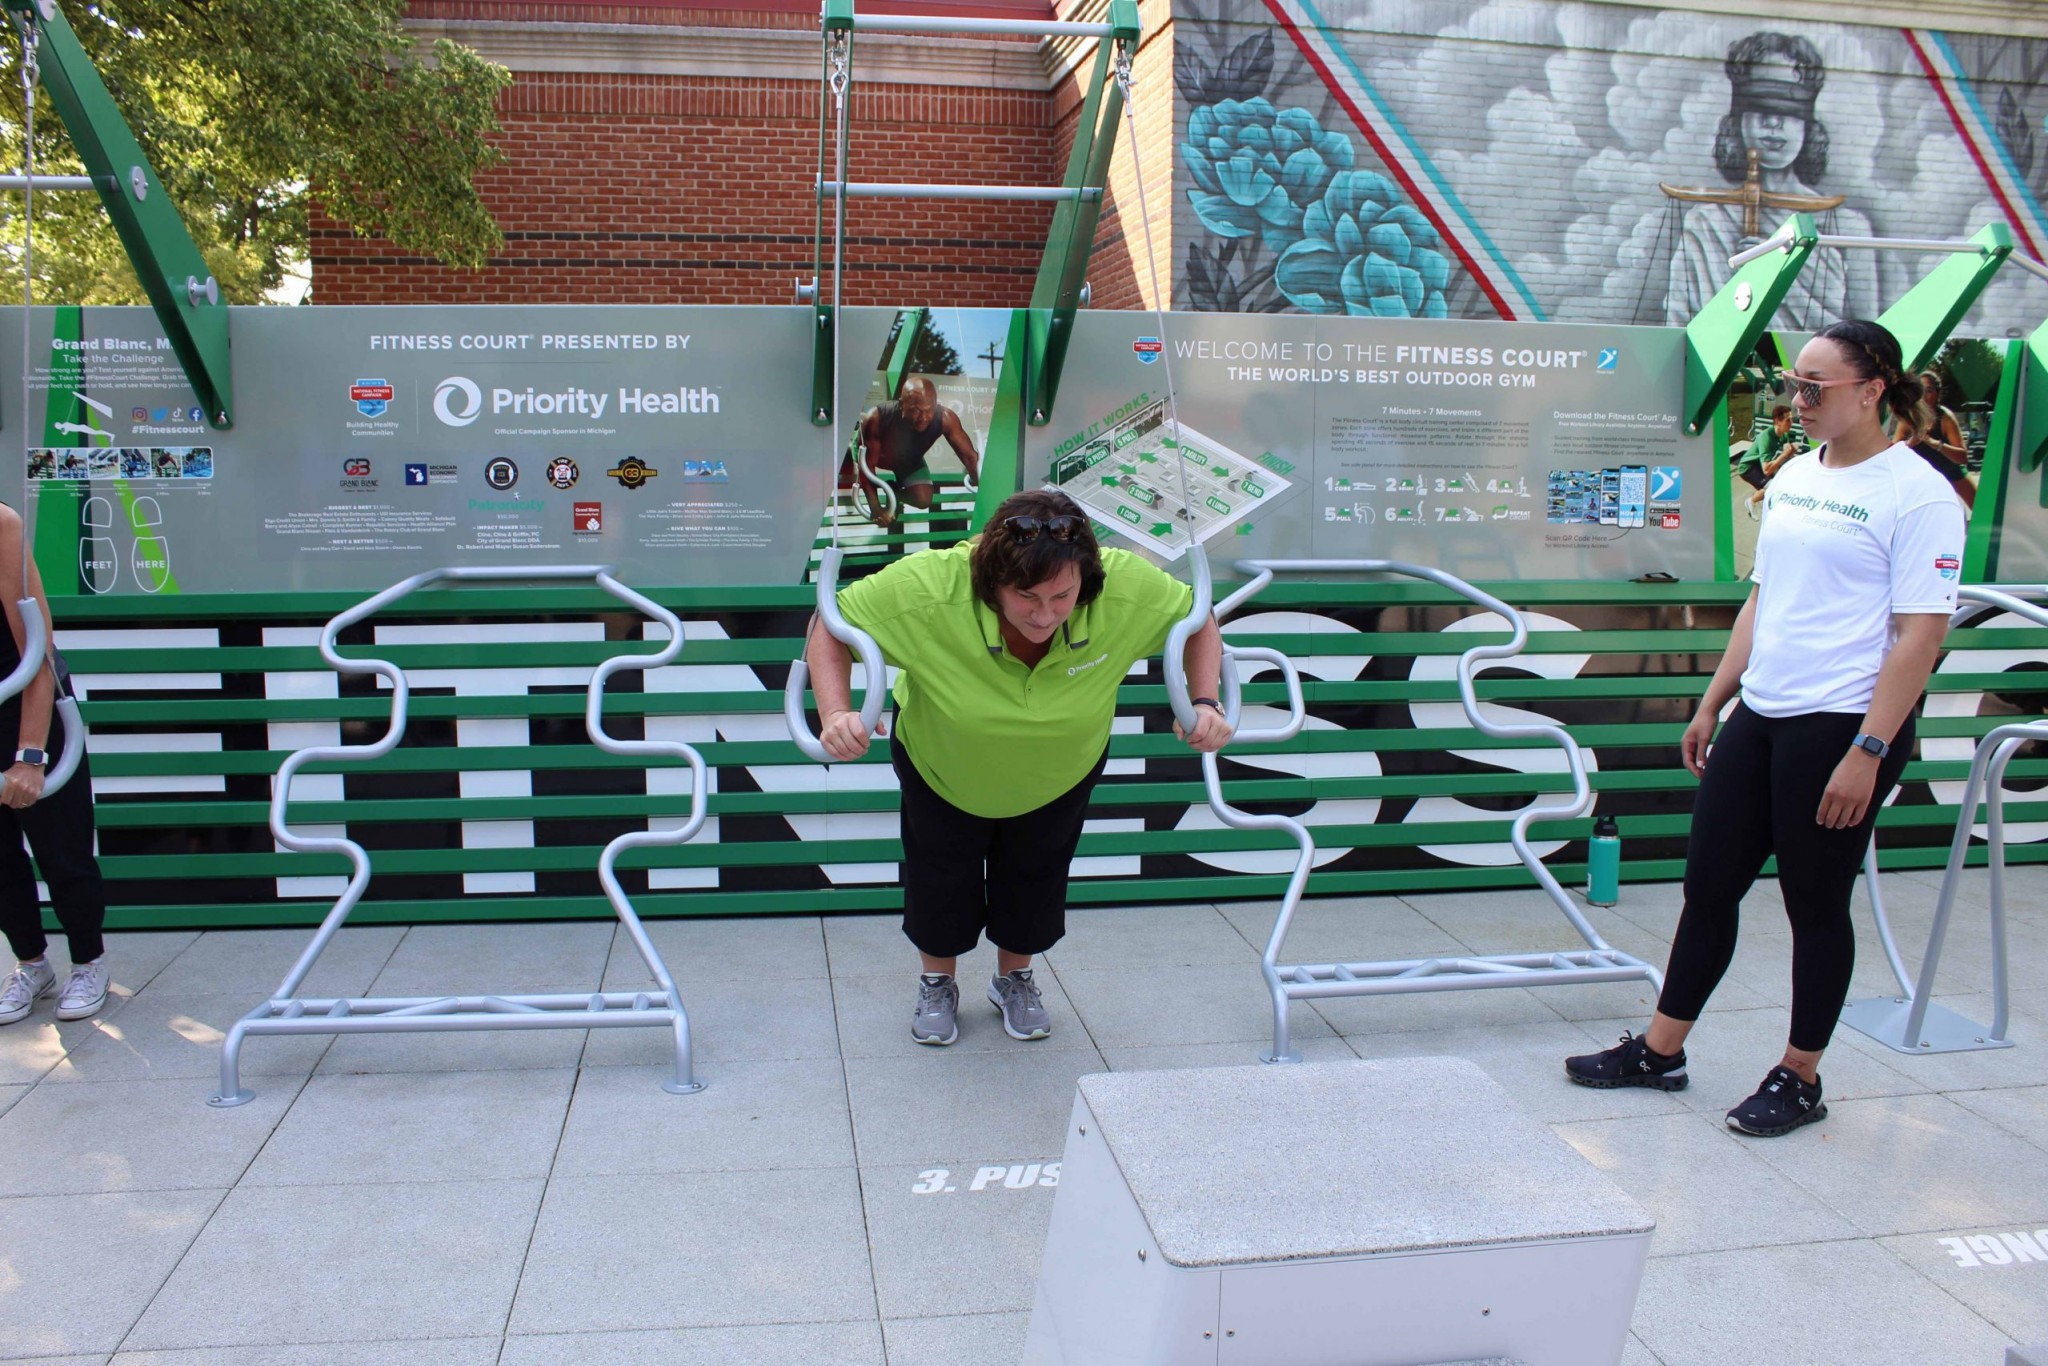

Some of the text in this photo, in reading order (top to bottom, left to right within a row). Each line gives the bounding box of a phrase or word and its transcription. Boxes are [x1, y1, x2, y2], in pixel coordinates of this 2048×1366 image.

[52, 338, 99, 350] Grand
[104, 338, 152, 352] Blanc,
[370, 335, 452, 350] FITNESS
[542, 335, 658, 349] PRESENTED
[665, 335, 690, 349] BY
[62, 354, 164, 364] Take the Challenge
[1175, 340, 1292, 360] WELCOME
[1302, 343, 1332, 362] TO
[1343, 344, 1386, 363] THE
[1396, 346, 1494, 366] FITNESS
[112, 366, 136, 374] yourself
[138, 366, 160, 374] against
[1227, 366, 1536, 388] THE WORLD'S BEST OUTDOOR GYM
[74, 382, 89, 390] push
[154, 382, 166, 390] long
[492, 386, 720, 418] Priority Health
[1389, 407, 1421, 415] Minutes
[1436, 408, 1482, 416] Movements
[1554, 410, 1592, 420] Download
[1594, 412, 1606, 420] the
[1608, 412, 1634, 421] Fitness
[1662, 414, 1678, 423] App
[132, 424, 204, 434] #Fitnesscourt
[518, 428, 550, 436] Campaign
[552, 428, 578, 436] Sponsor
[587, 428, 616, 436] Michigan
[1054, 392, 1150, 457] HOW IT WORKS
[1118, 432, 1137, 447] 5 PULL
[1092, 448, 1108, 463] PUSH
[1186, 448, 1206, 466] AGILITY
[1256, 451, 1296, 476] FINISH
[1246, 482, 1263, 498] BEND
[1324, 477, 1333, 492] 1
[1385, 478, 1397, 492] 2
[1434, 478, 1446, 492] 3
[1486, 479, 1498, 493] 4
[1134, 488, 1152, 504] SQUAT
[468, 499, 545, 512] Patronicity
[1212, 499, 1230, 514] LUNGE
[1778, 493, 1868, 522] Priority Health
[1124, 508, 1140, 523] CORE
[1324, 506, 1336, 522] 5
[1385, 507, 1396, 522] 6
[1434, 507, 1446, 522] 7
[85, 560, 112, 570] FEET
[136, 560, 166, 568] HERE
[912, 1162, 1062, 1194] 3. PUS
[1937, 1229, 2048, 1268] NGE
